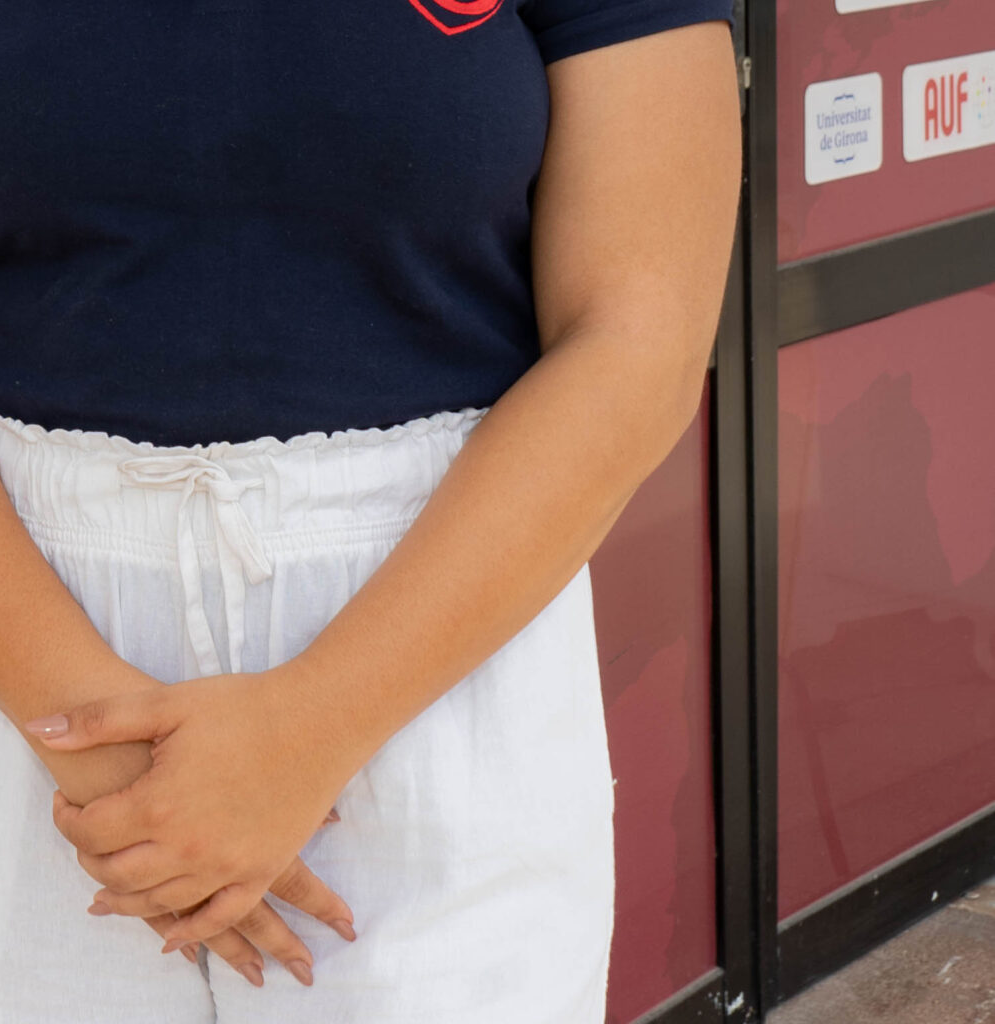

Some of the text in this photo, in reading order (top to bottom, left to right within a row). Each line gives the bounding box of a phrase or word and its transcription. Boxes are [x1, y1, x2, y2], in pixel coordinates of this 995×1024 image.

[816, 106, 872, 131] Universitat
[924, 72, 969, 142] AUF
[820, 129, 869, 152] de Girona
